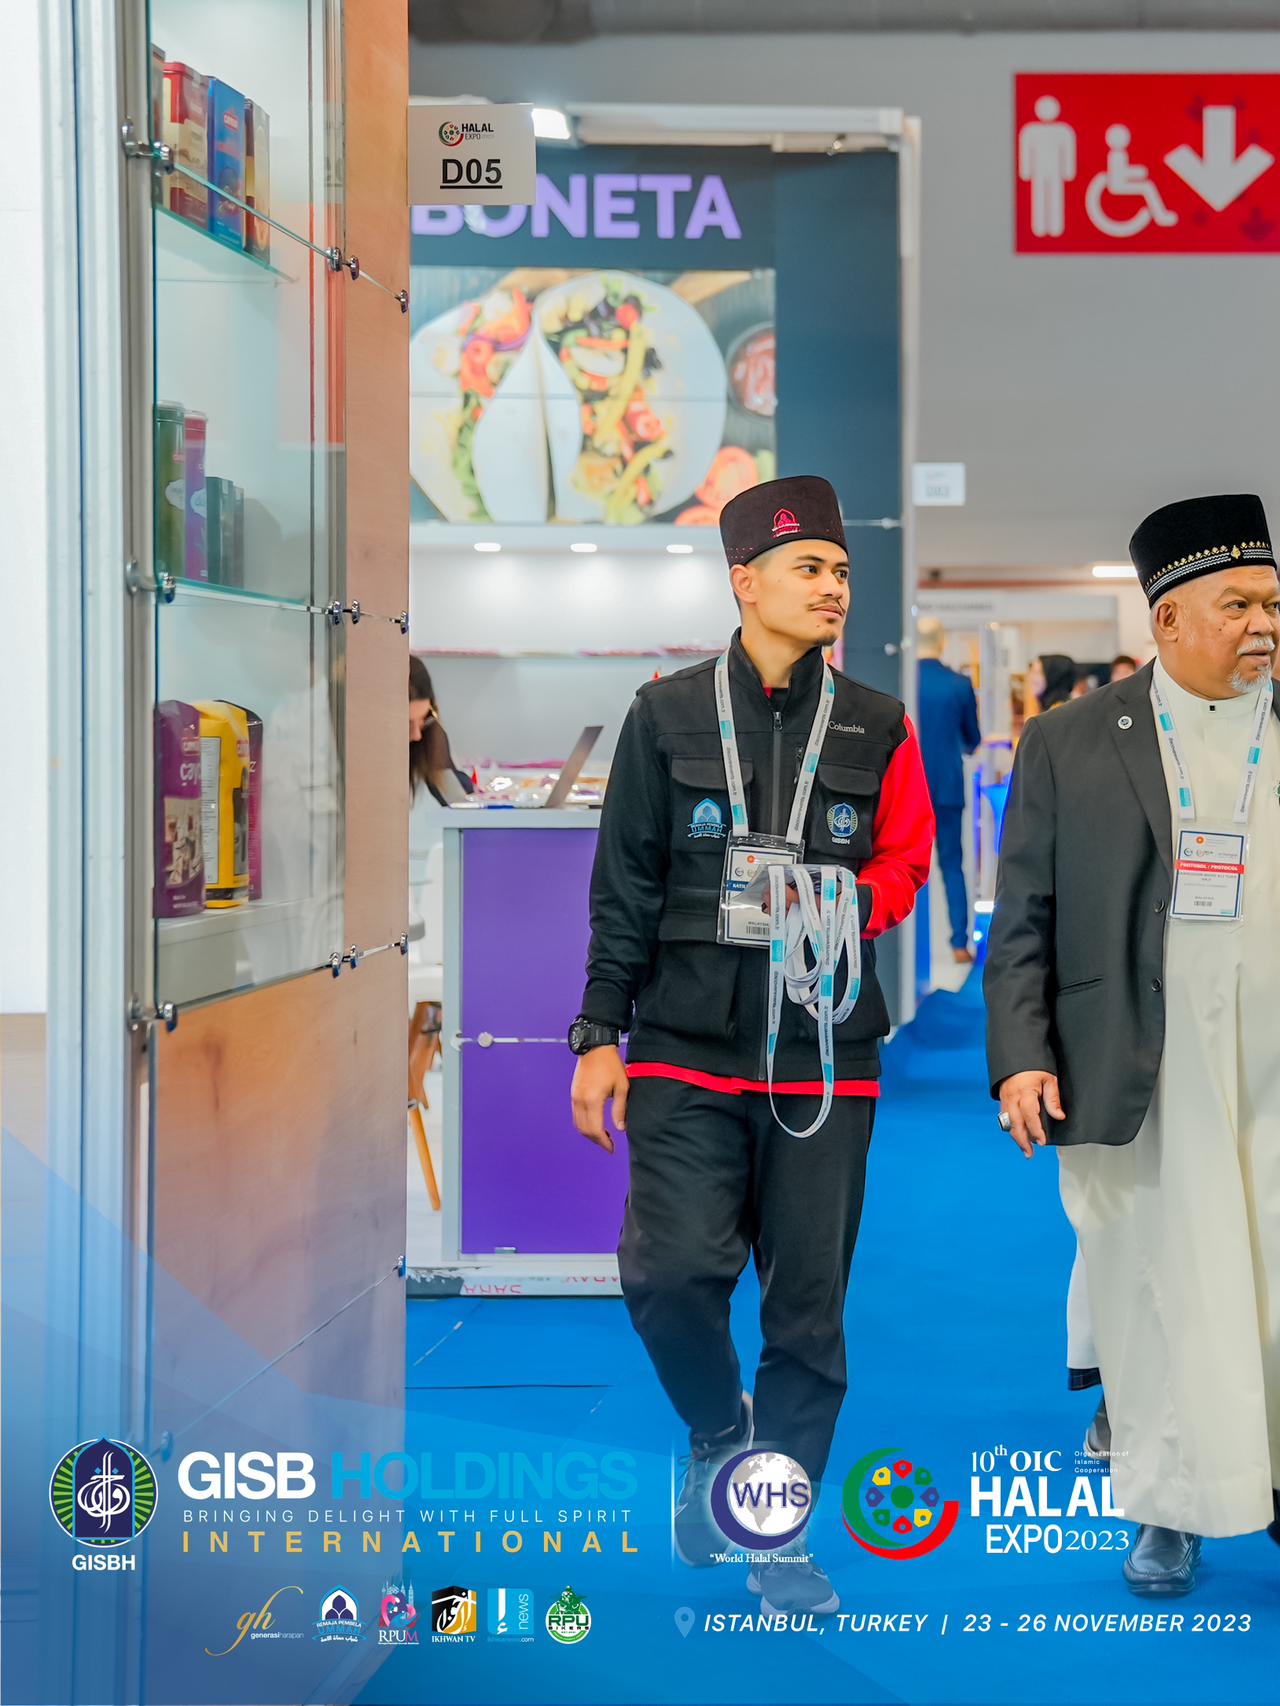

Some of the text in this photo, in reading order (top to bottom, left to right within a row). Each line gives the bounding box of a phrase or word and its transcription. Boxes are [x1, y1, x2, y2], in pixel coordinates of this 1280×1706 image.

[461, 123, 494, 133] HALAL
[442, 158, 502, 185] D05
[828, 720, 865, 734] Columbia
